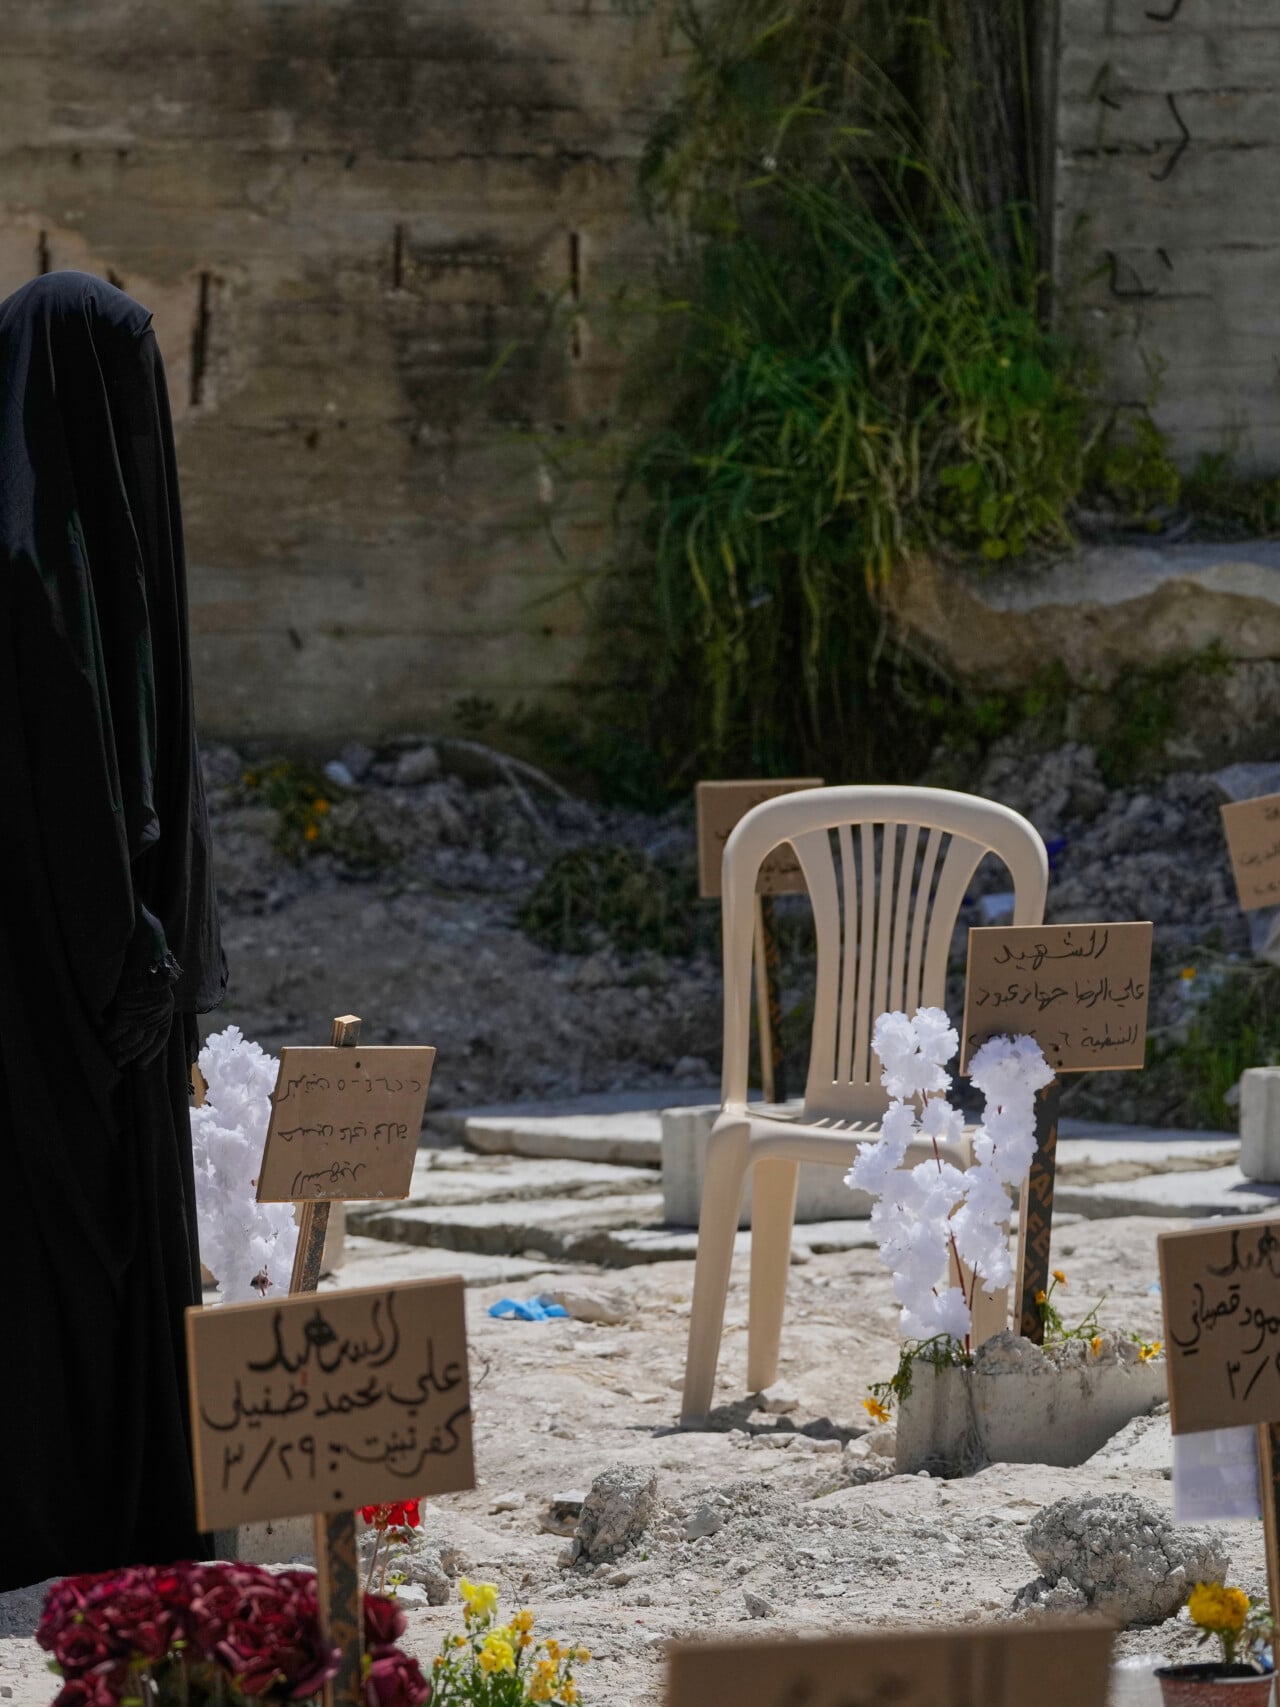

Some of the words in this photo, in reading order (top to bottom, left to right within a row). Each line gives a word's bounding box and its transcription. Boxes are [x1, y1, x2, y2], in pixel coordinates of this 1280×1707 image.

[994, 928, 1110, 972] الشهيد
[1110, 978, 1146, 1009] علي
[277, 1124, 334, 1146] حسين
[340, 1121, 367, 1144] علي
[291, 1161, 367, 1196] الشهيد
[313, 1375, 386, 1418] محمد
[386, 1337, 464, 1418] علي
